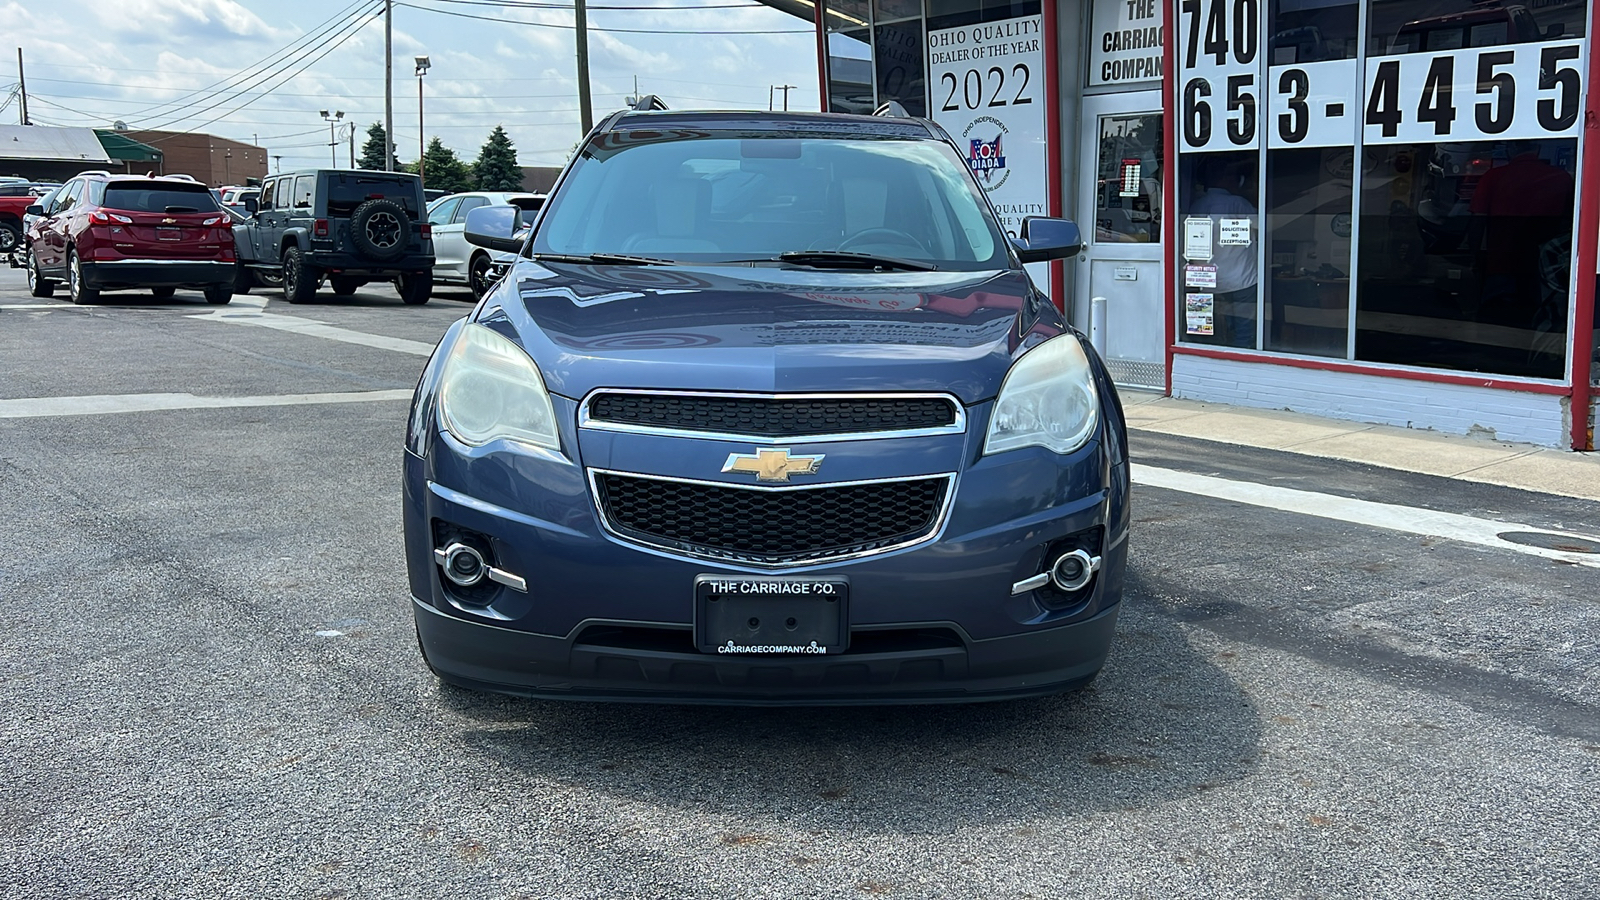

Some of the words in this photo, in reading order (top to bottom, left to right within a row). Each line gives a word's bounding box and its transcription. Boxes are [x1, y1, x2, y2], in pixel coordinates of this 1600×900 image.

[1127, 0, 1154, 20] THE
[930, 30, 966, 48] OHIO
[973, 19, 1041, 44] QUALITY
[1183, 0, 1257, 69] 740
[932, 49, 970, 64] DEALER
[972, 47, 985, 59] OF
[987, 43, 1009, 57] THE
[1011, 39, 1039, 54] YEAR
[941, 63, 1032, 112] 2022
[962, 122, 974, 138] OHIO
[973, 116, 1009, 134] INDEPENDENT
[972, 158, 999, 169] OIADA
[995, 204, 1043, 215] QUALITY
[710, 582, 737, 594] THE
[740, 582, 809, 594] CARRIAGE
[812, 583, 836, 594] CO.
[717, 645, 827, 655] CARRIAGECOMPANY.COM
